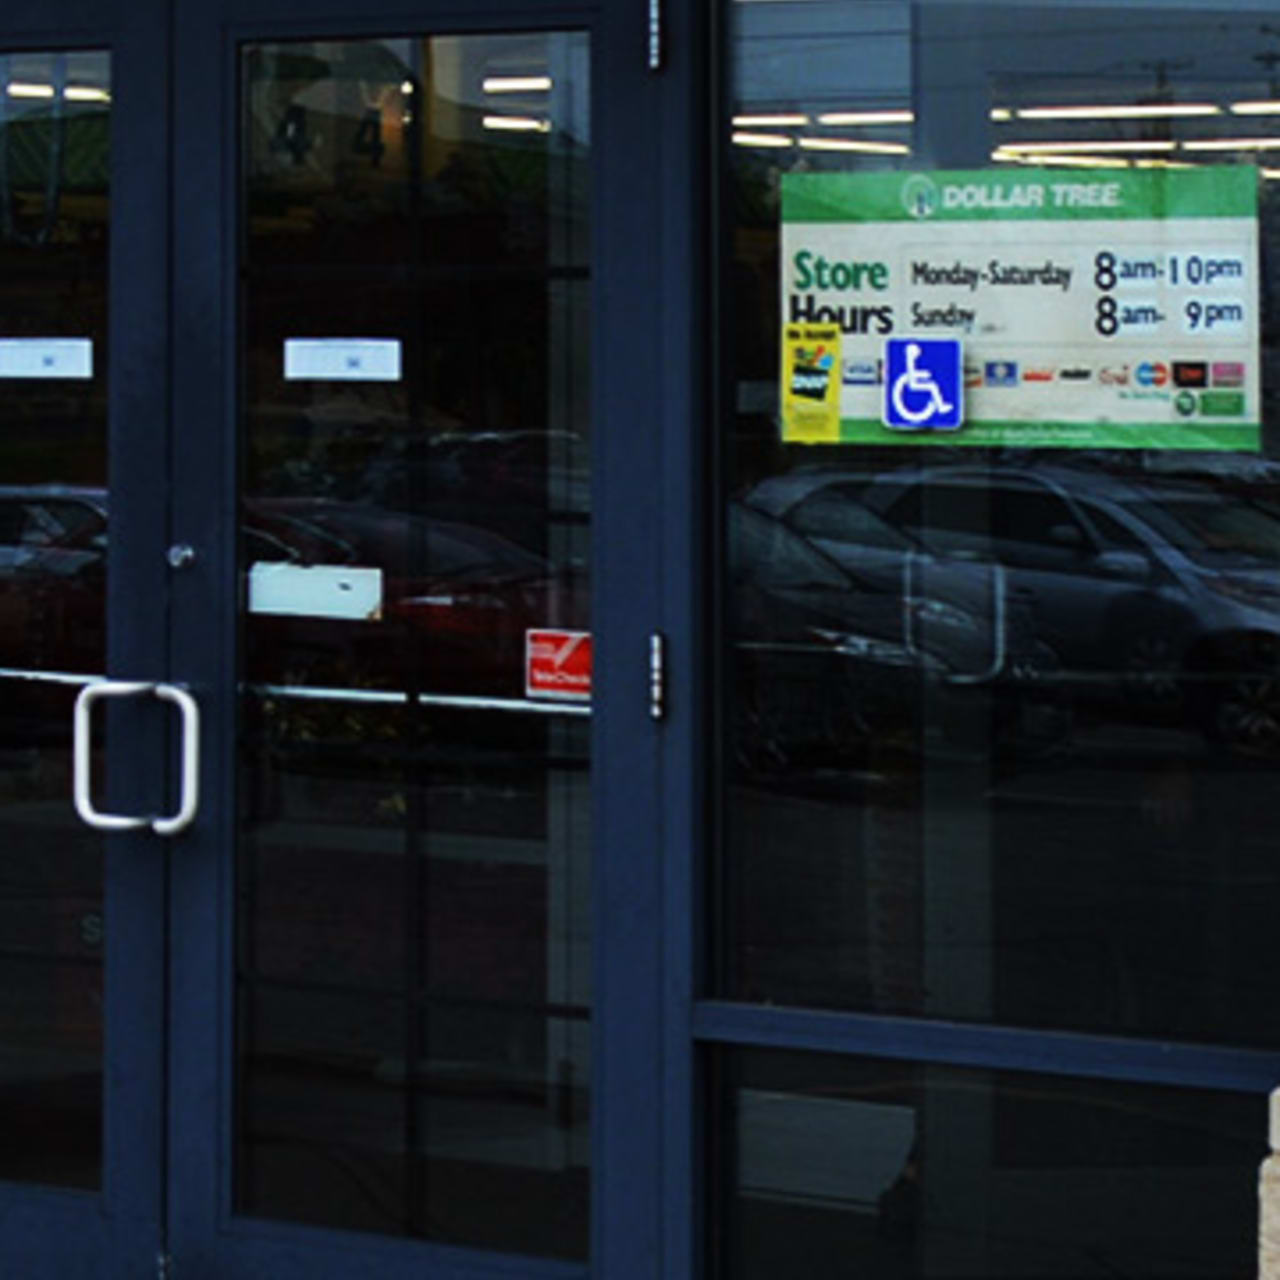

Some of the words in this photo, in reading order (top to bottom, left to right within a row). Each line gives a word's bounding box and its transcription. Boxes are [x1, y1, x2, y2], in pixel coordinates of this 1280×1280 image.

[943, 184, 1043, 208] DOLLAR
[1049, 182, 1122, 207] TREE
[793, 250, 890, 292] Store
[911, 259, 1073, 292] Monday-Saturday
[790, 295, 894, 336] Hours
[911, 301, 976, 334] Sunday
